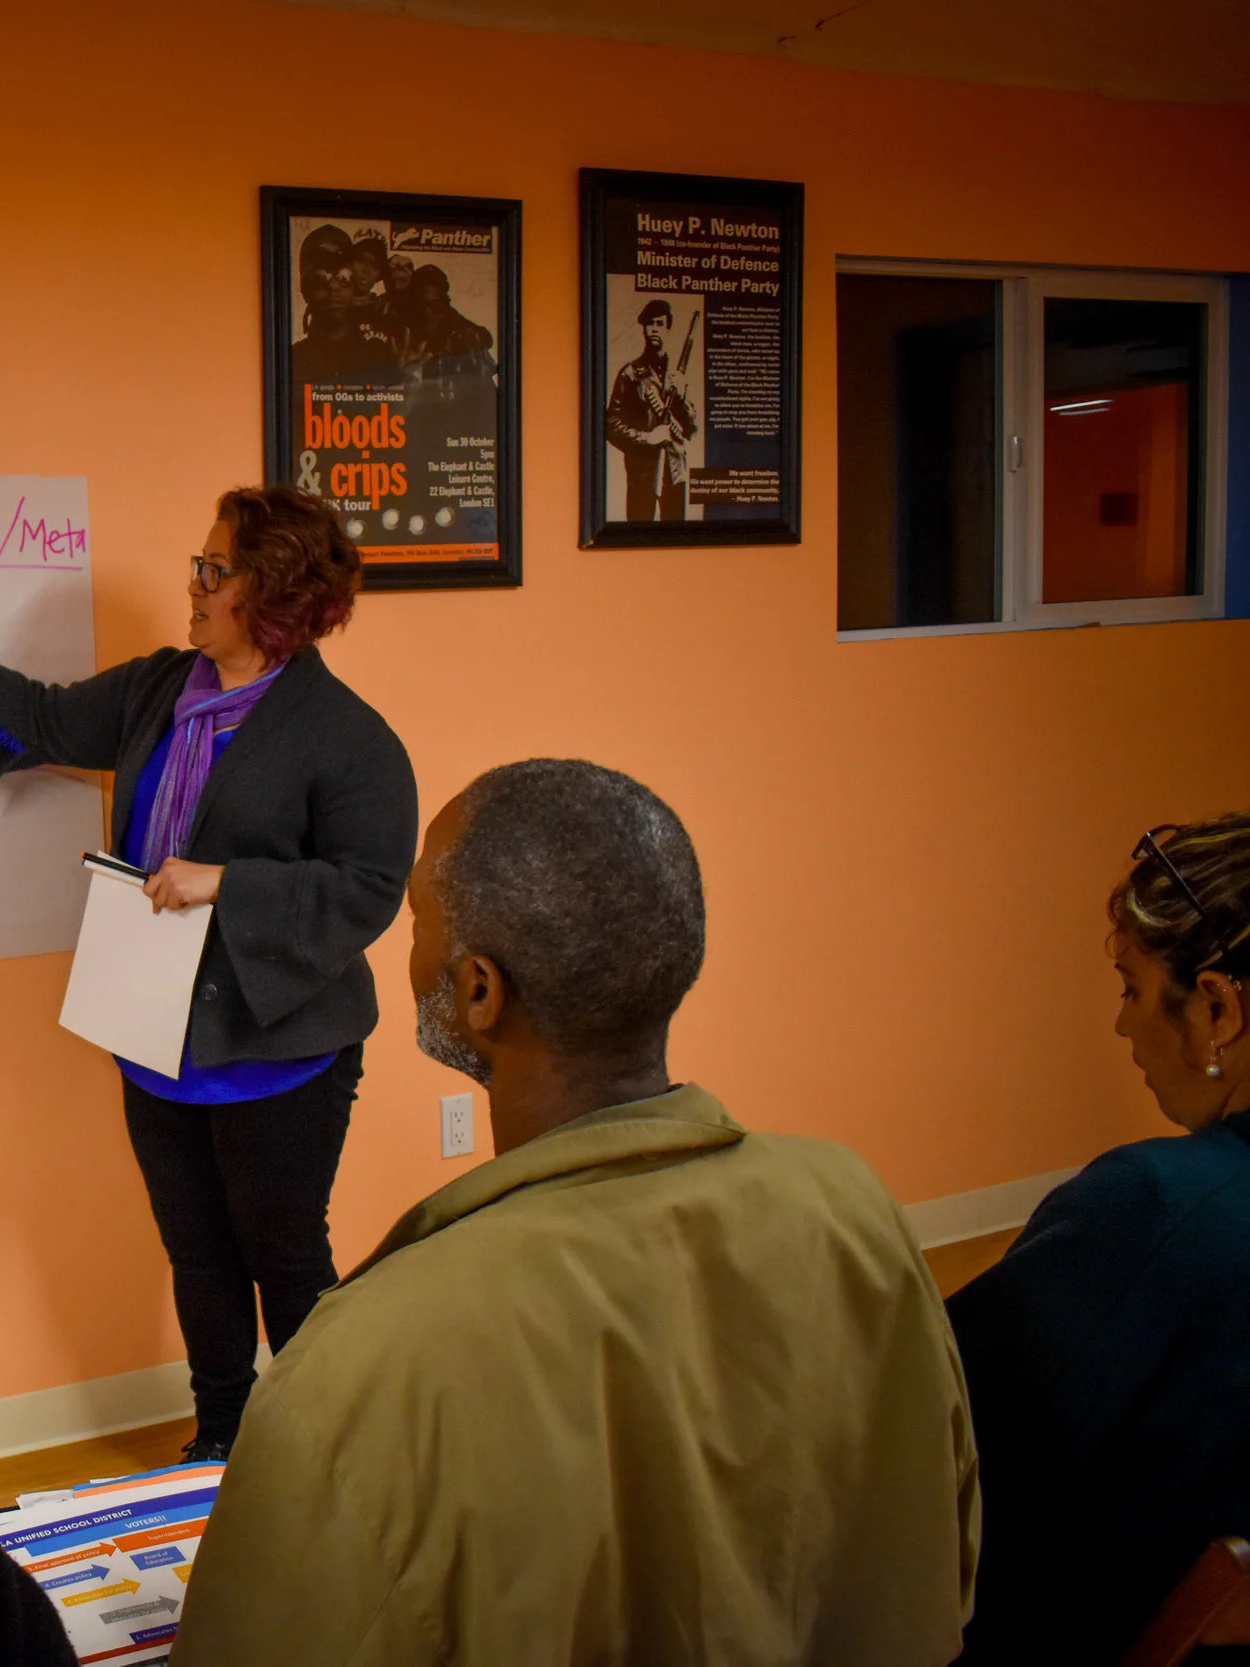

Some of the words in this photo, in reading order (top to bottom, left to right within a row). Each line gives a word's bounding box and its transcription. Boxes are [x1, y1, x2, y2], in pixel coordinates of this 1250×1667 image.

[637, 212, 683, 238] Huey
[688, 216, 706, 235] P.
[710, 218, 780, 239] Newton
[420, 228, 491, 246] Panther
[637, 251, 698, 268] Minister
[701, 255, 717, 269] of
[720, 255, 779, 272] Defence
[637, 273, 678, 289] Black
[681, 275, 738, 292] Panther
[741, 278, 780, 297] Party
[312, 392, 334, 401] from
[335, 392, 354, 401] OGs
[355, 393, 365, 401] to
[366, 393, 405, 402] activists
[304, 383, 407, 449] bloods
[446, 437, 459, 447] Sun
[469, 437, 495, 447] October
[428, 461, 439, 472] The
[440, 461, 468, 472] Elephant
[475, 461, 495, 471] Castle
[297, 450, 322, 497] &
[330, 451, 408, 511] crips
[448, 473, 471, 484] Leisure
[472, 473, 495, 484] Centre,
[429, 486, 438, 496] 22
[439, 486, 466, 498] Elephant
[344, 499, 372, 511] tour
[459, 498, 482, 508] London
[0, 1538, 13, 1548] LA
[14, 1529, 52, 1544] UNIFIED
[53, 1519, 92, 1534] SCHOOL
[93, 1508, 133, 1524] DISTRICT
[125, 1515, 167, 1530] VOTERS!!
